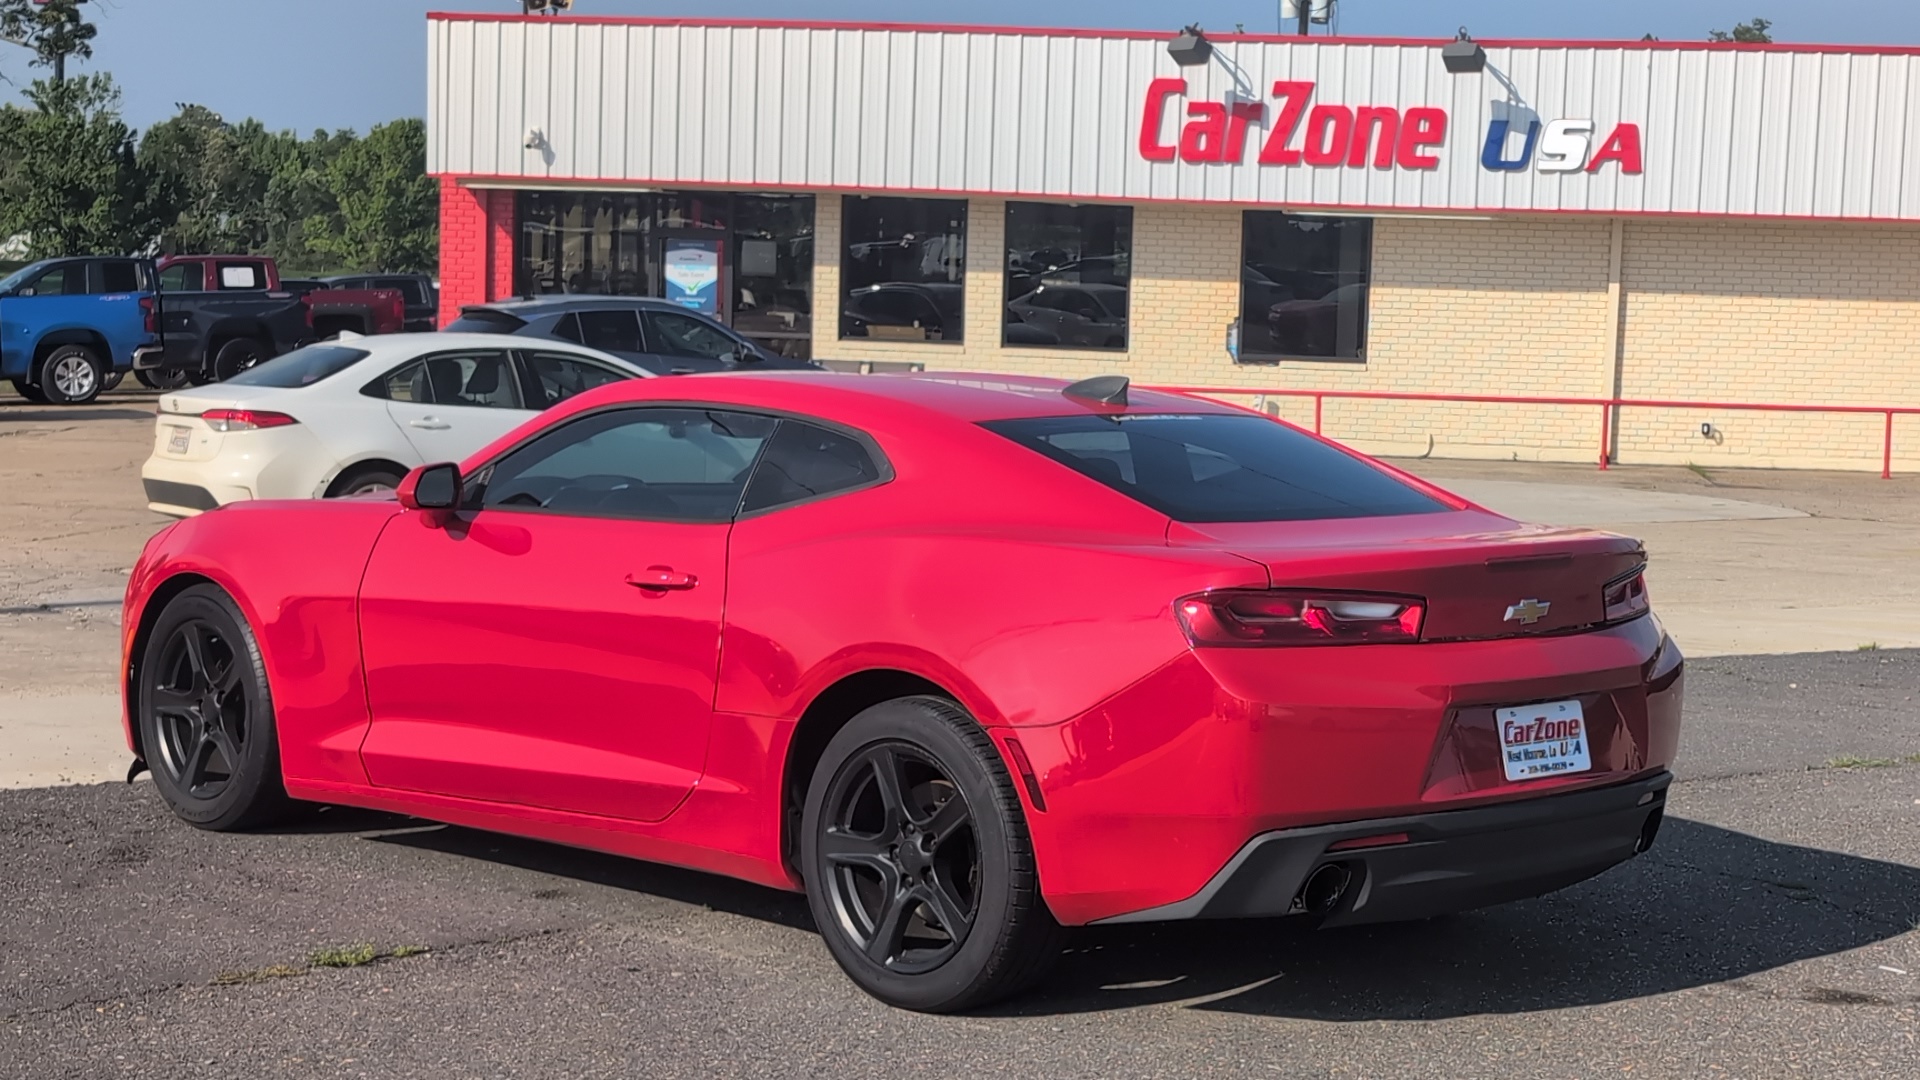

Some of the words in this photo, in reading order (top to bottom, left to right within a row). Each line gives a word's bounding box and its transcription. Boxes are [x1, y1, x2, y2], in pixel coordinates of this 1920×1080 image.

[1139, 78, 1448, 169] CarZone
[1481, 119, 1643, 173] USA
[1504, 717, 1580, 745] CarZone
[1561, 740, 1582, 756] UA
